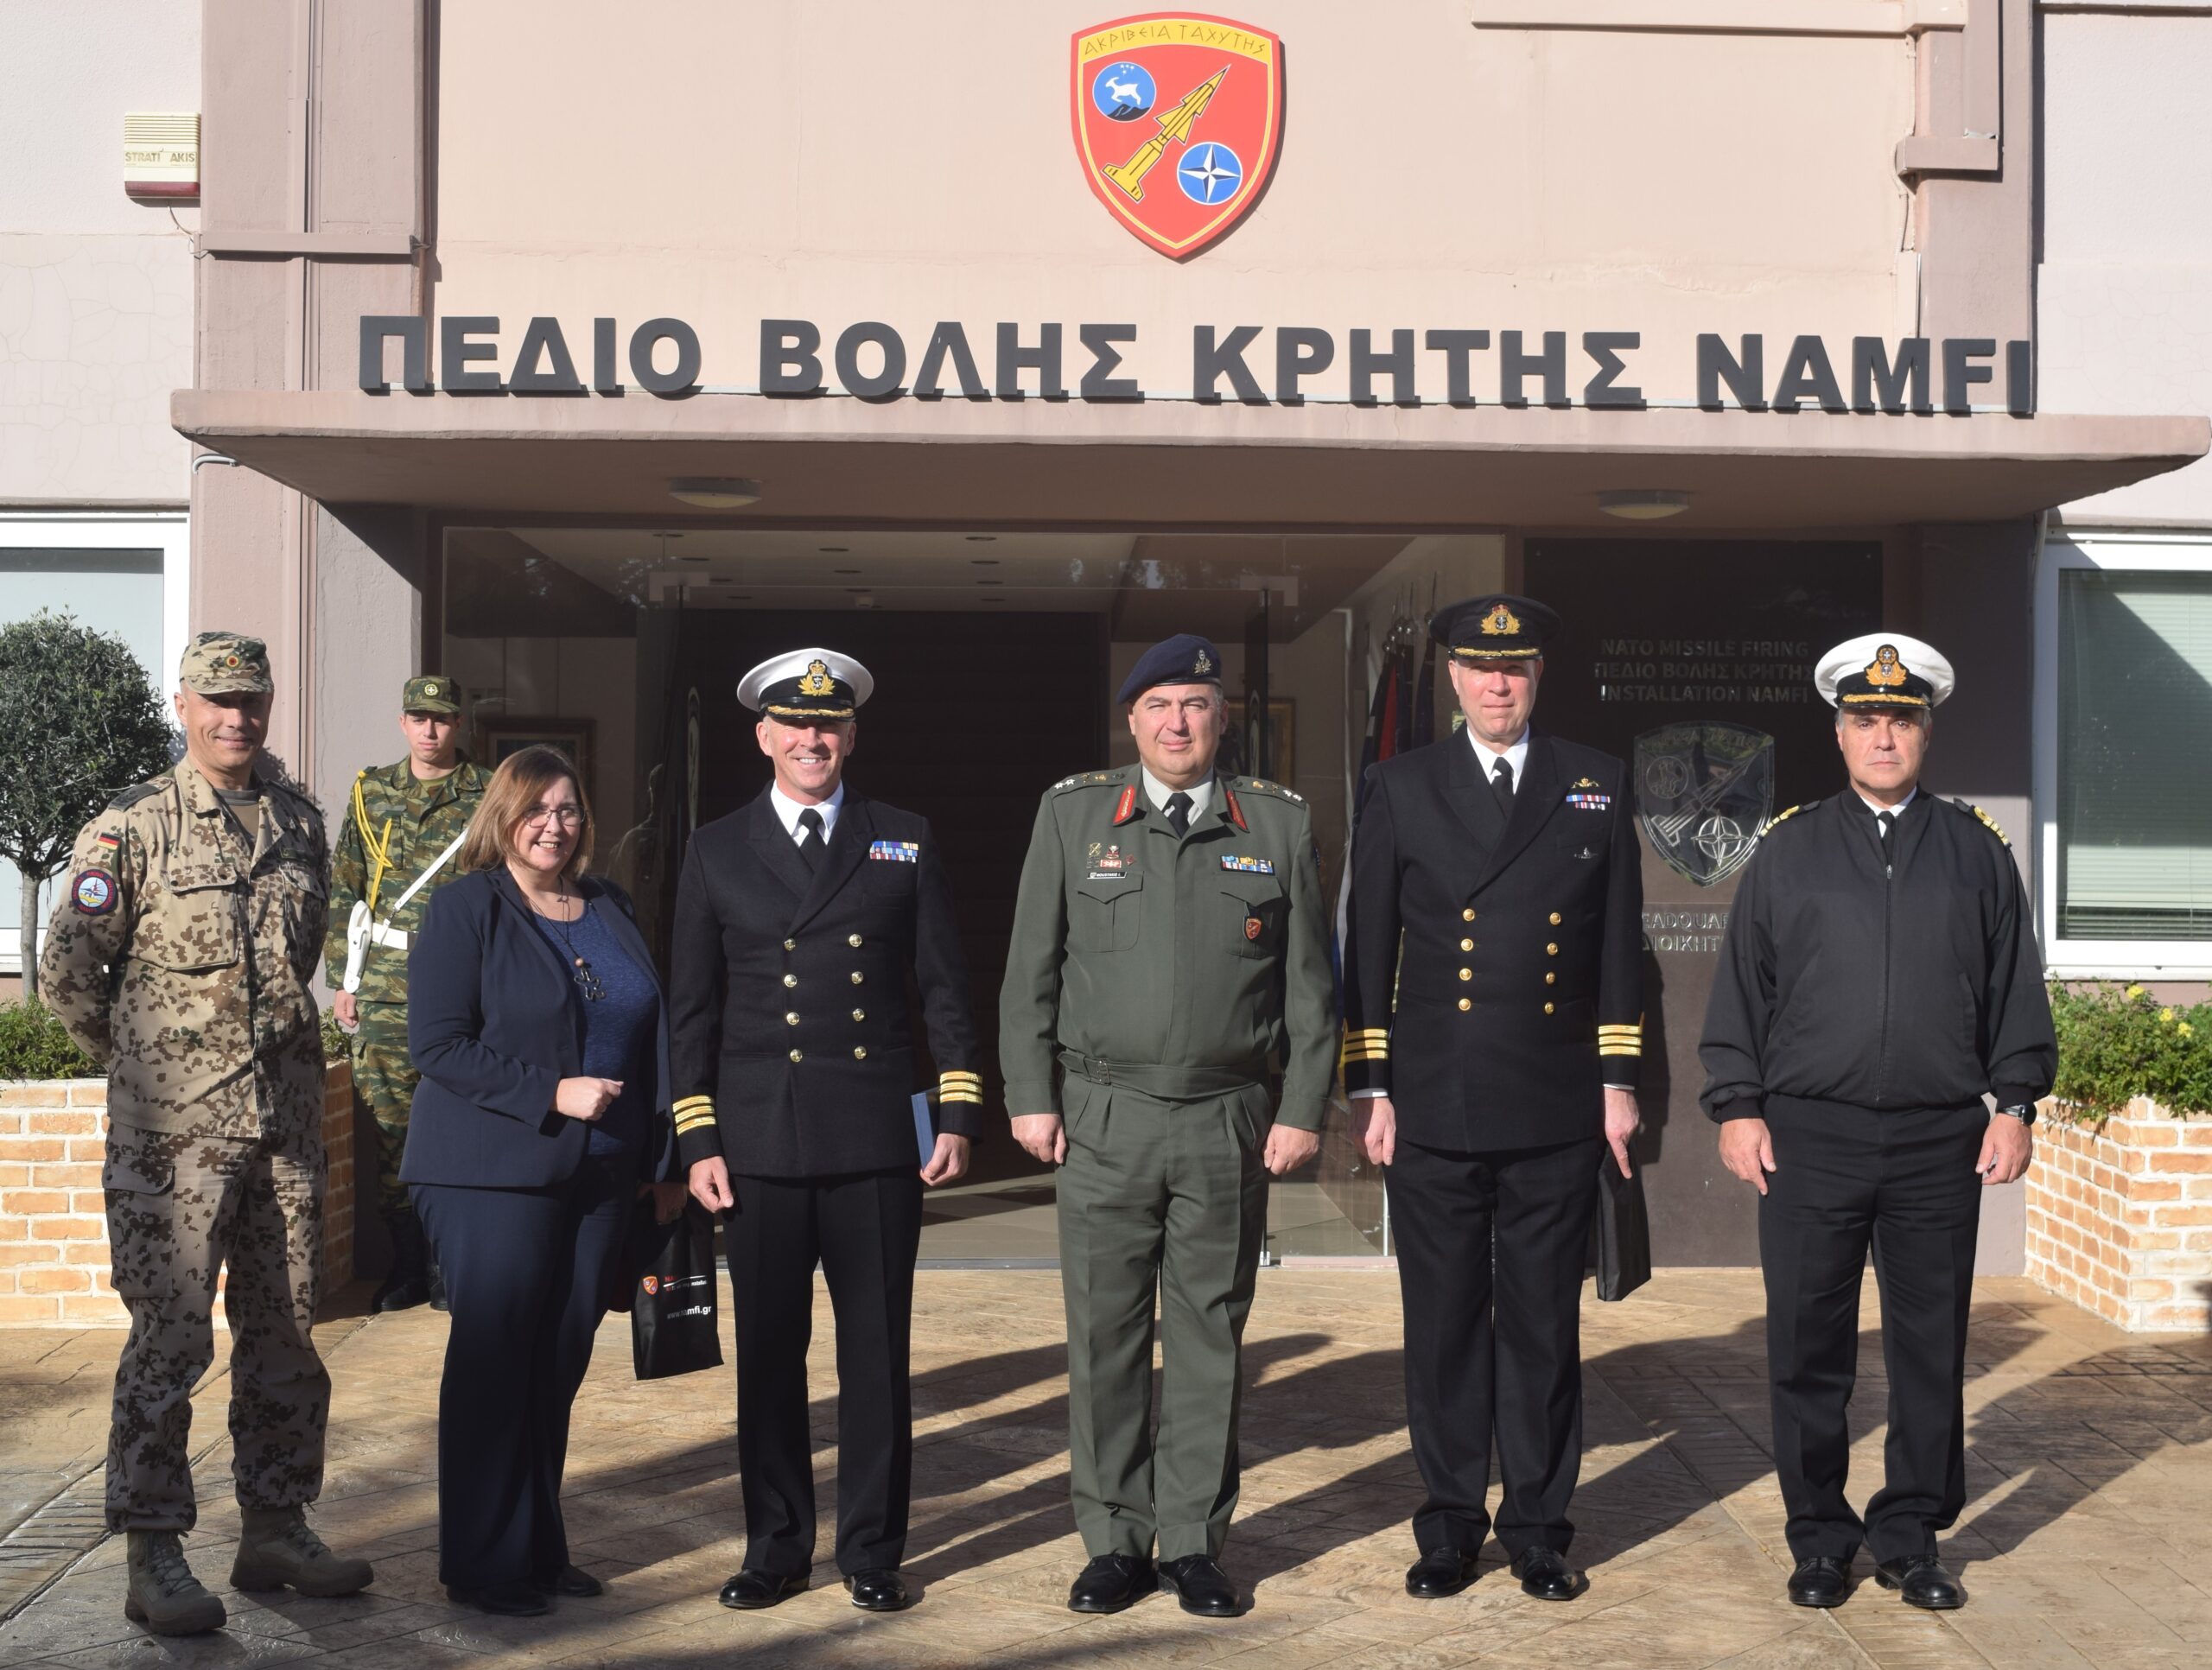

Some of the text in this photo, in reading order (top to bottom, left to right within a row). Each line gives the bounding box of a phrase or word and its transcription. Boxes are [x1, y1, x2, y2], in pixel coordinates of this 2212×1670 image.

[359, 315, 2032, 415] ΠΕΔΙΟ ΒΟΛΗΣ ΚΡΗΤΗΣ NAMFI
[1601, 639, 1809, 658] NATO MISSILE FIRING
[1594, 663, 1815, 681] ΠΕΔΙΟ ΒΟΛΗΣ ΚΡΗΤΗΣ
[1600, 684, 1808, 703] INSTALLATION NAMFI
[1641, 911, 1729, 932] EADQUA
